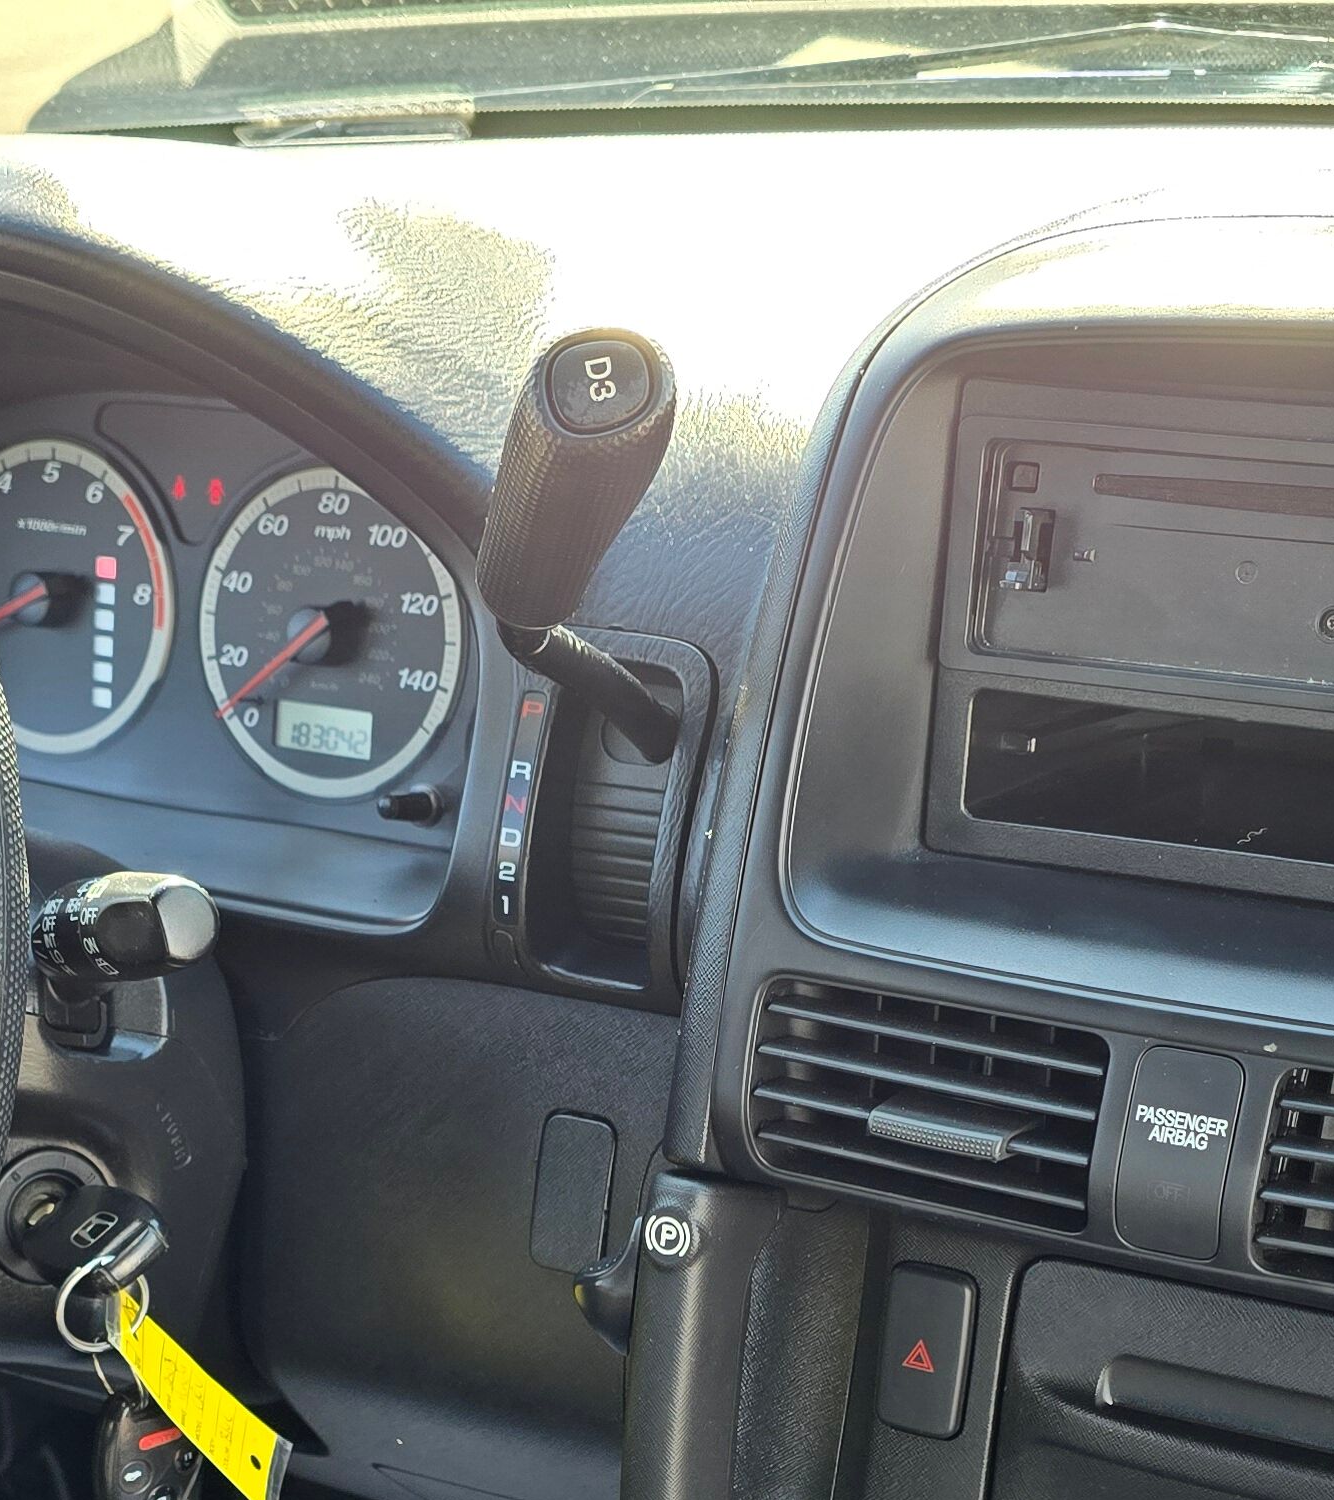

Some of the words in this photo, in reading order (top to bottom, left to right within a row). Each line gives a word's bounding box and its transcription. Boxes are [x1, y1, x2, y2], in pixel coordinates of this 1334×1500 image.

[584, 356, 617, 402] D3
[41, 461, 62, 483] 5
[85, 481, 105, 504] 6
[318, 492, 349, 515] 80
[117, 525, 135, 546] 7
[258, 513, 289, 537] 60
[314, 524, 350, 543] mph
[368, 524, 407, 548] 100
[223, 571, 252, 593] 40
[133, 583, 152, 606] 8
[401, 592, 439, 616] 120
[220, 644, 249, 667] 20
[398, 667, 437, 692] 140
[243, 707, 259, 728] 0
[521, 701, 544, 719] P
[511, 760, 532, 781] R
[505, 794, 527, 814] N
[500, 827, 521, 847] D
[498, 861, 516, 881] 2
[501, 895, 509, 914] 1
[42, 916, 57, 932] OFF
[80, 907, 99, 925] OFF
[83, 937, 100, 954] ON
[1135, 1104, 1229, 1137] PASSENGER
[1147, 1125, 1208, 1151] AIRBAG
